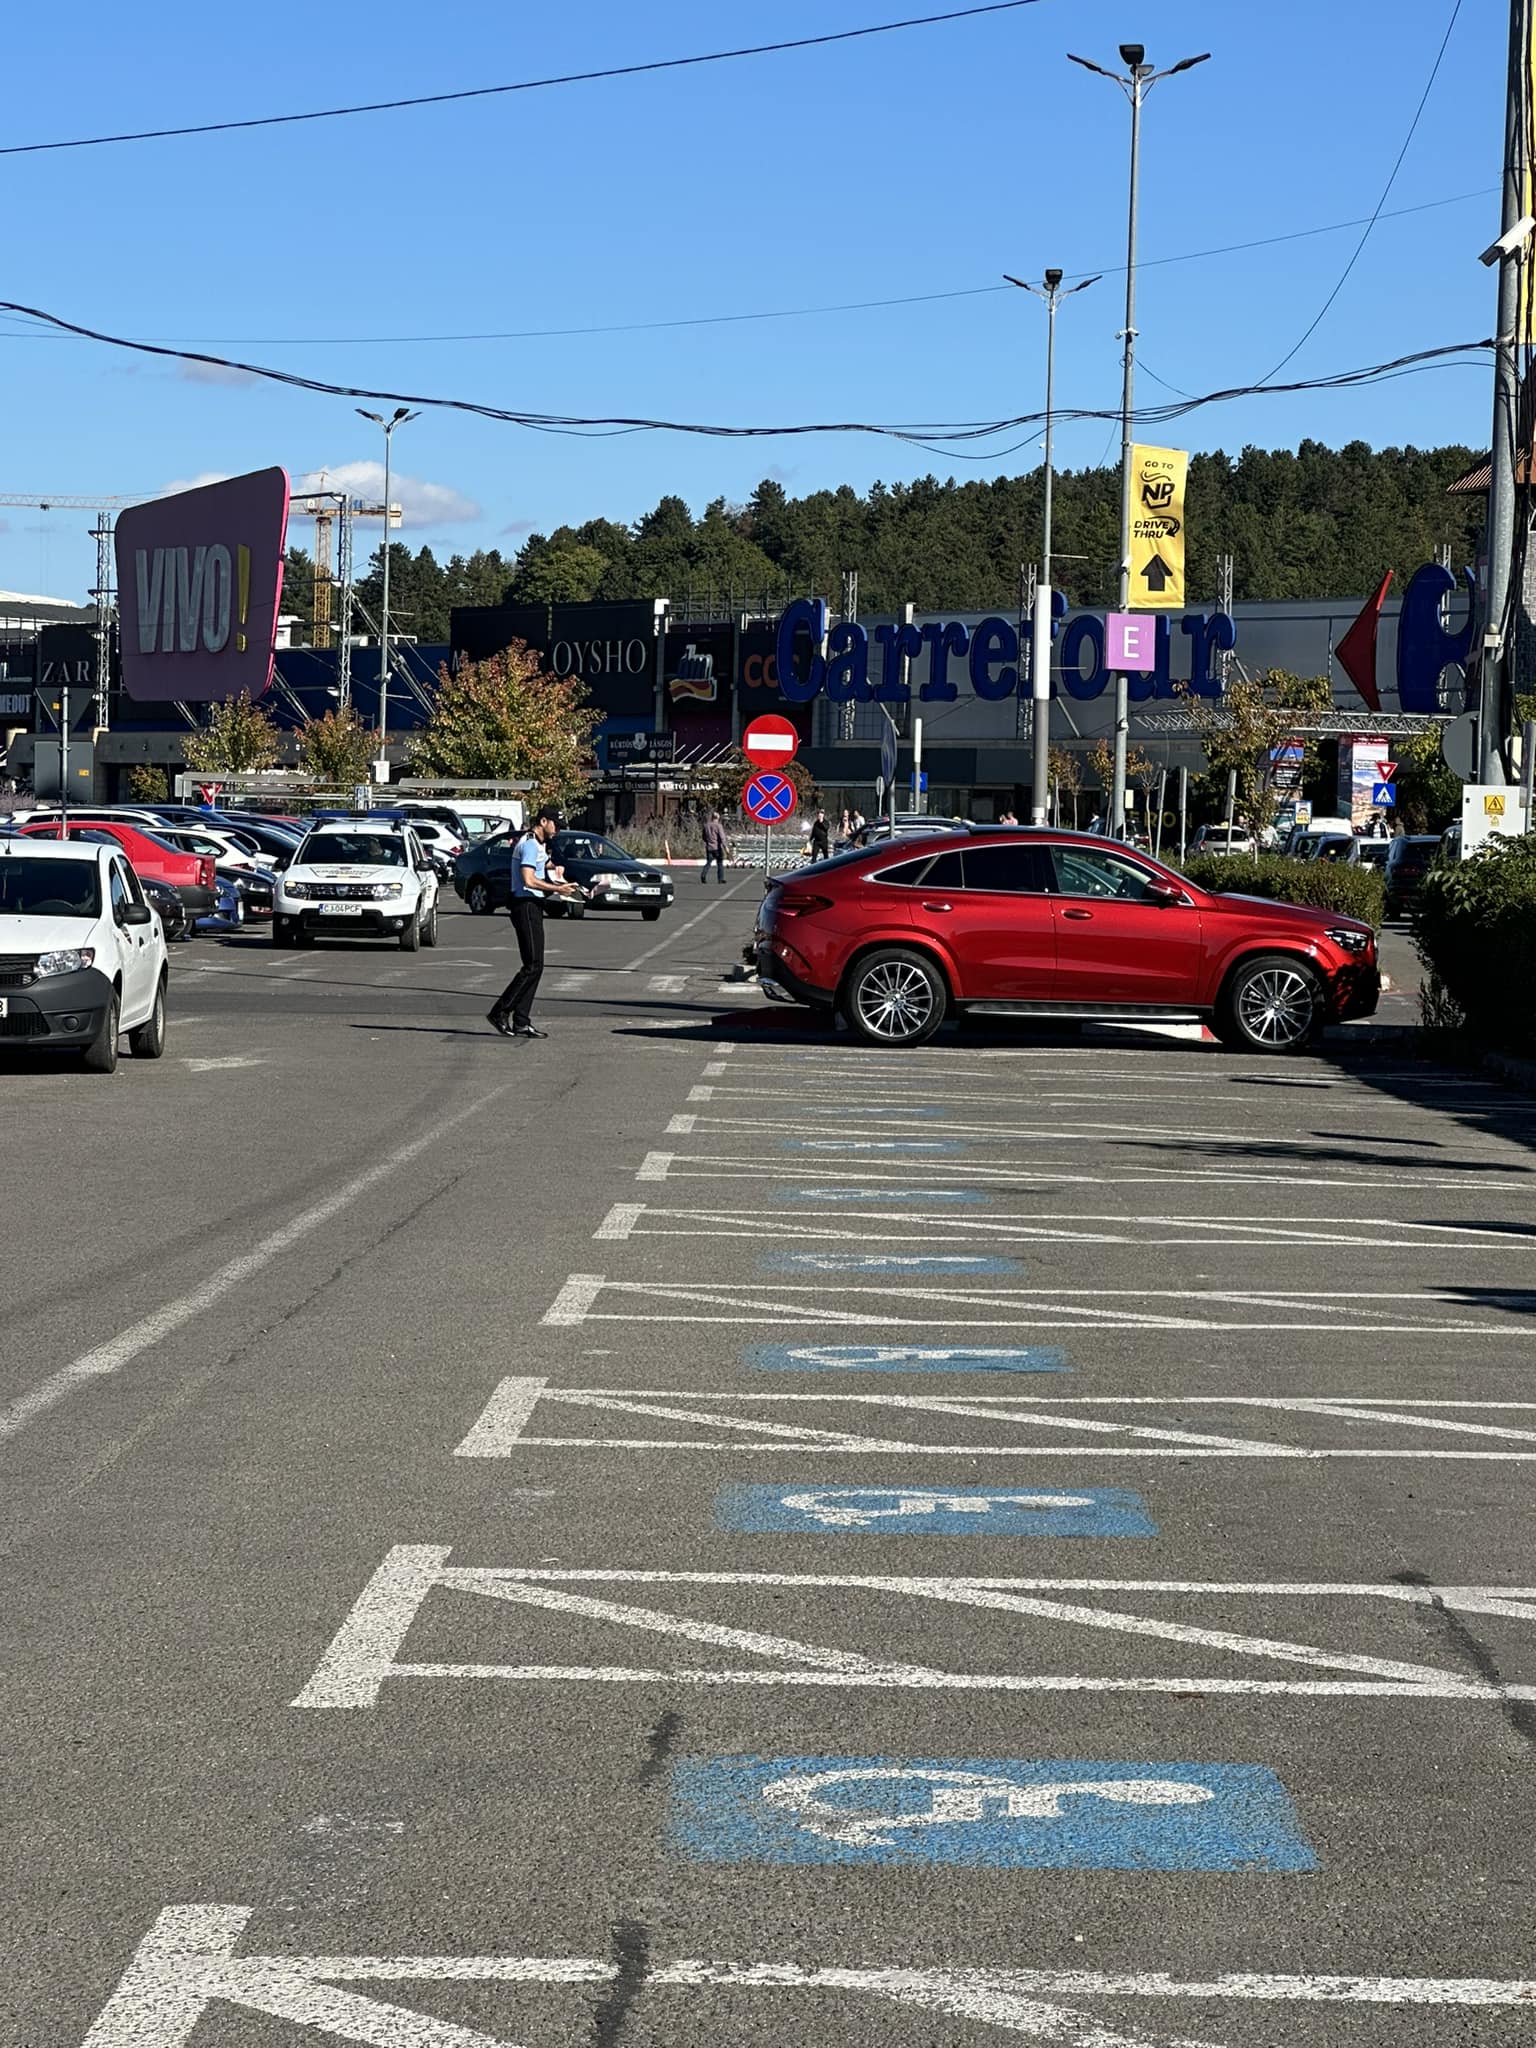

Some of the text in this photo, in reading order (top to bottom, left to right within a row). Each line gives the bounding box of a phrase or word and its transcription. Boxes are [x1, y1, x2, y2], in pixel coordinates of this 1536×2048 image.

[1144, 460, 1174, 470] GO TO
[1141, 482, 1175, 502] NP
[1133, 530, 1164, 539] THRU
[1134, 520, 1169, 530] DRIVE
[135, 543, 250, 654] VIVO!
[1124, 626, 1139, 658] E
[552, 638, 647, 676] OYSHO
